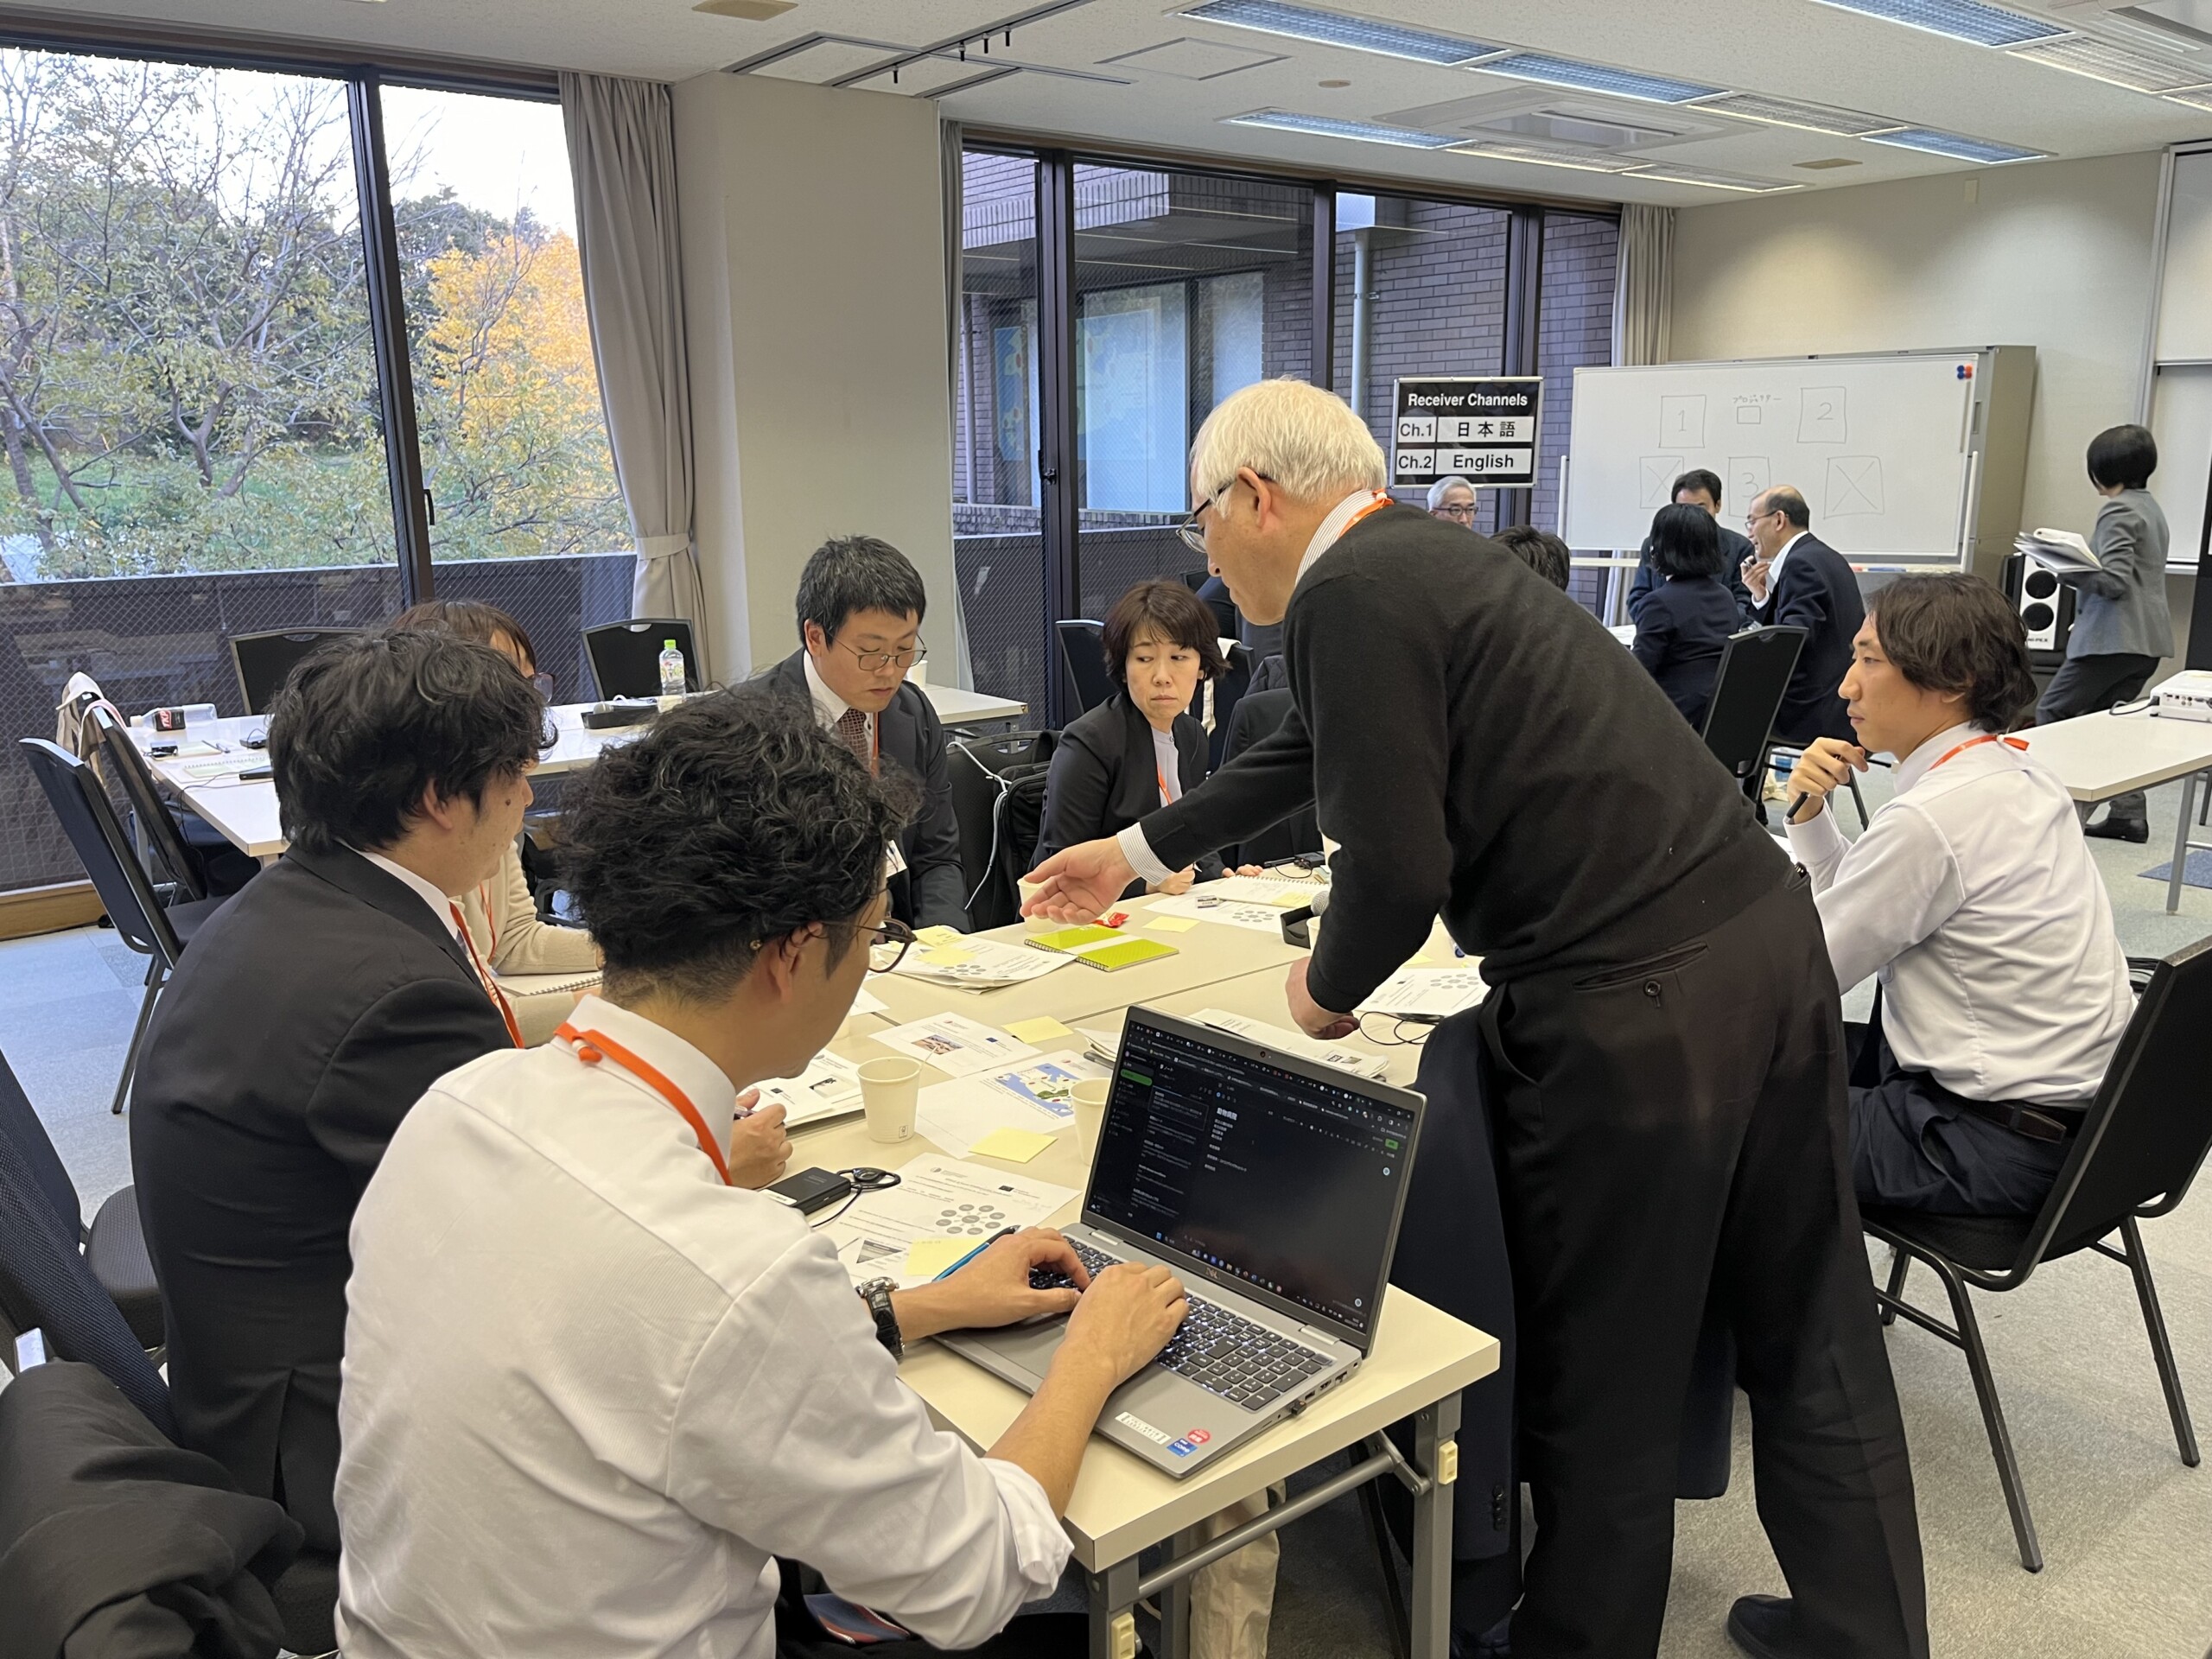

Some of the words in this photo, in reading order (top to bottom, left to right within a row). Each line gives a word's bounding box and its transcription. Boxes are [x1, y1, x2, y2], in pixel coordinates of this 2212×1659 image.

[1408, 393, 1465, 407] Receiver
[1467, 393, 1528, 407] Channels
[1817, 402, 1834, 420] 2
[1458, 421, 1516, 438] 日本語
[1678, 410, 1687, 432] 1
[1400, 423, 1433, 437] Ch.1
[1398, 455, 1432, 469] Ch.2
[1452, 454, 1514, 472] English
[1741, 472, 1759, 498] 3
